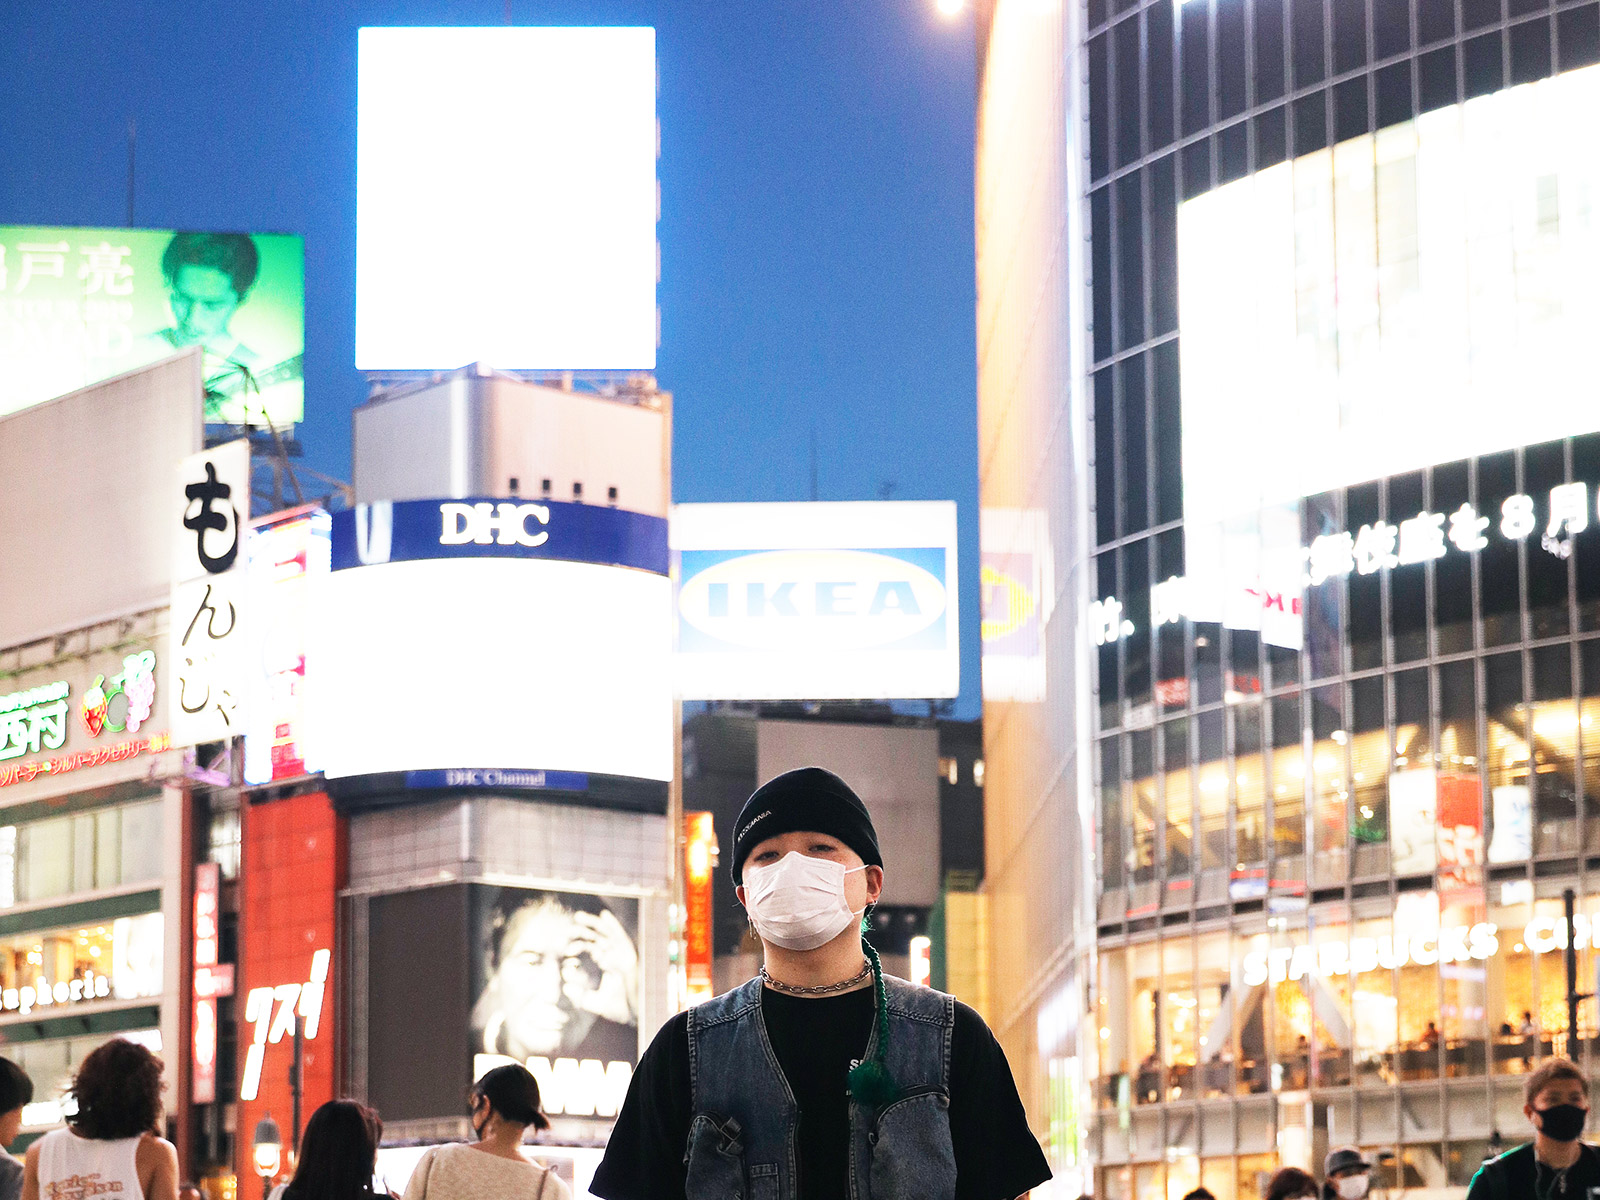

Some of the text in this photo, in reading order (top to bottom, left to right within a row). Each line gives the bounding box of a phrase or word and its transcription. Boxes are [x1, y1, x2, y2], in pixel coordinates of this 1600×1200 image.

[0, 240, 134, 296] 戸亮
[439, 503, 550, 547] DHC
[708, 580, 921, 617] IKEA
[446, 769, 546, 787] DHC Channel
[1243, 922, 1499, 986] STARBUCKS
[0, 970, 110, 1015] uphoria
